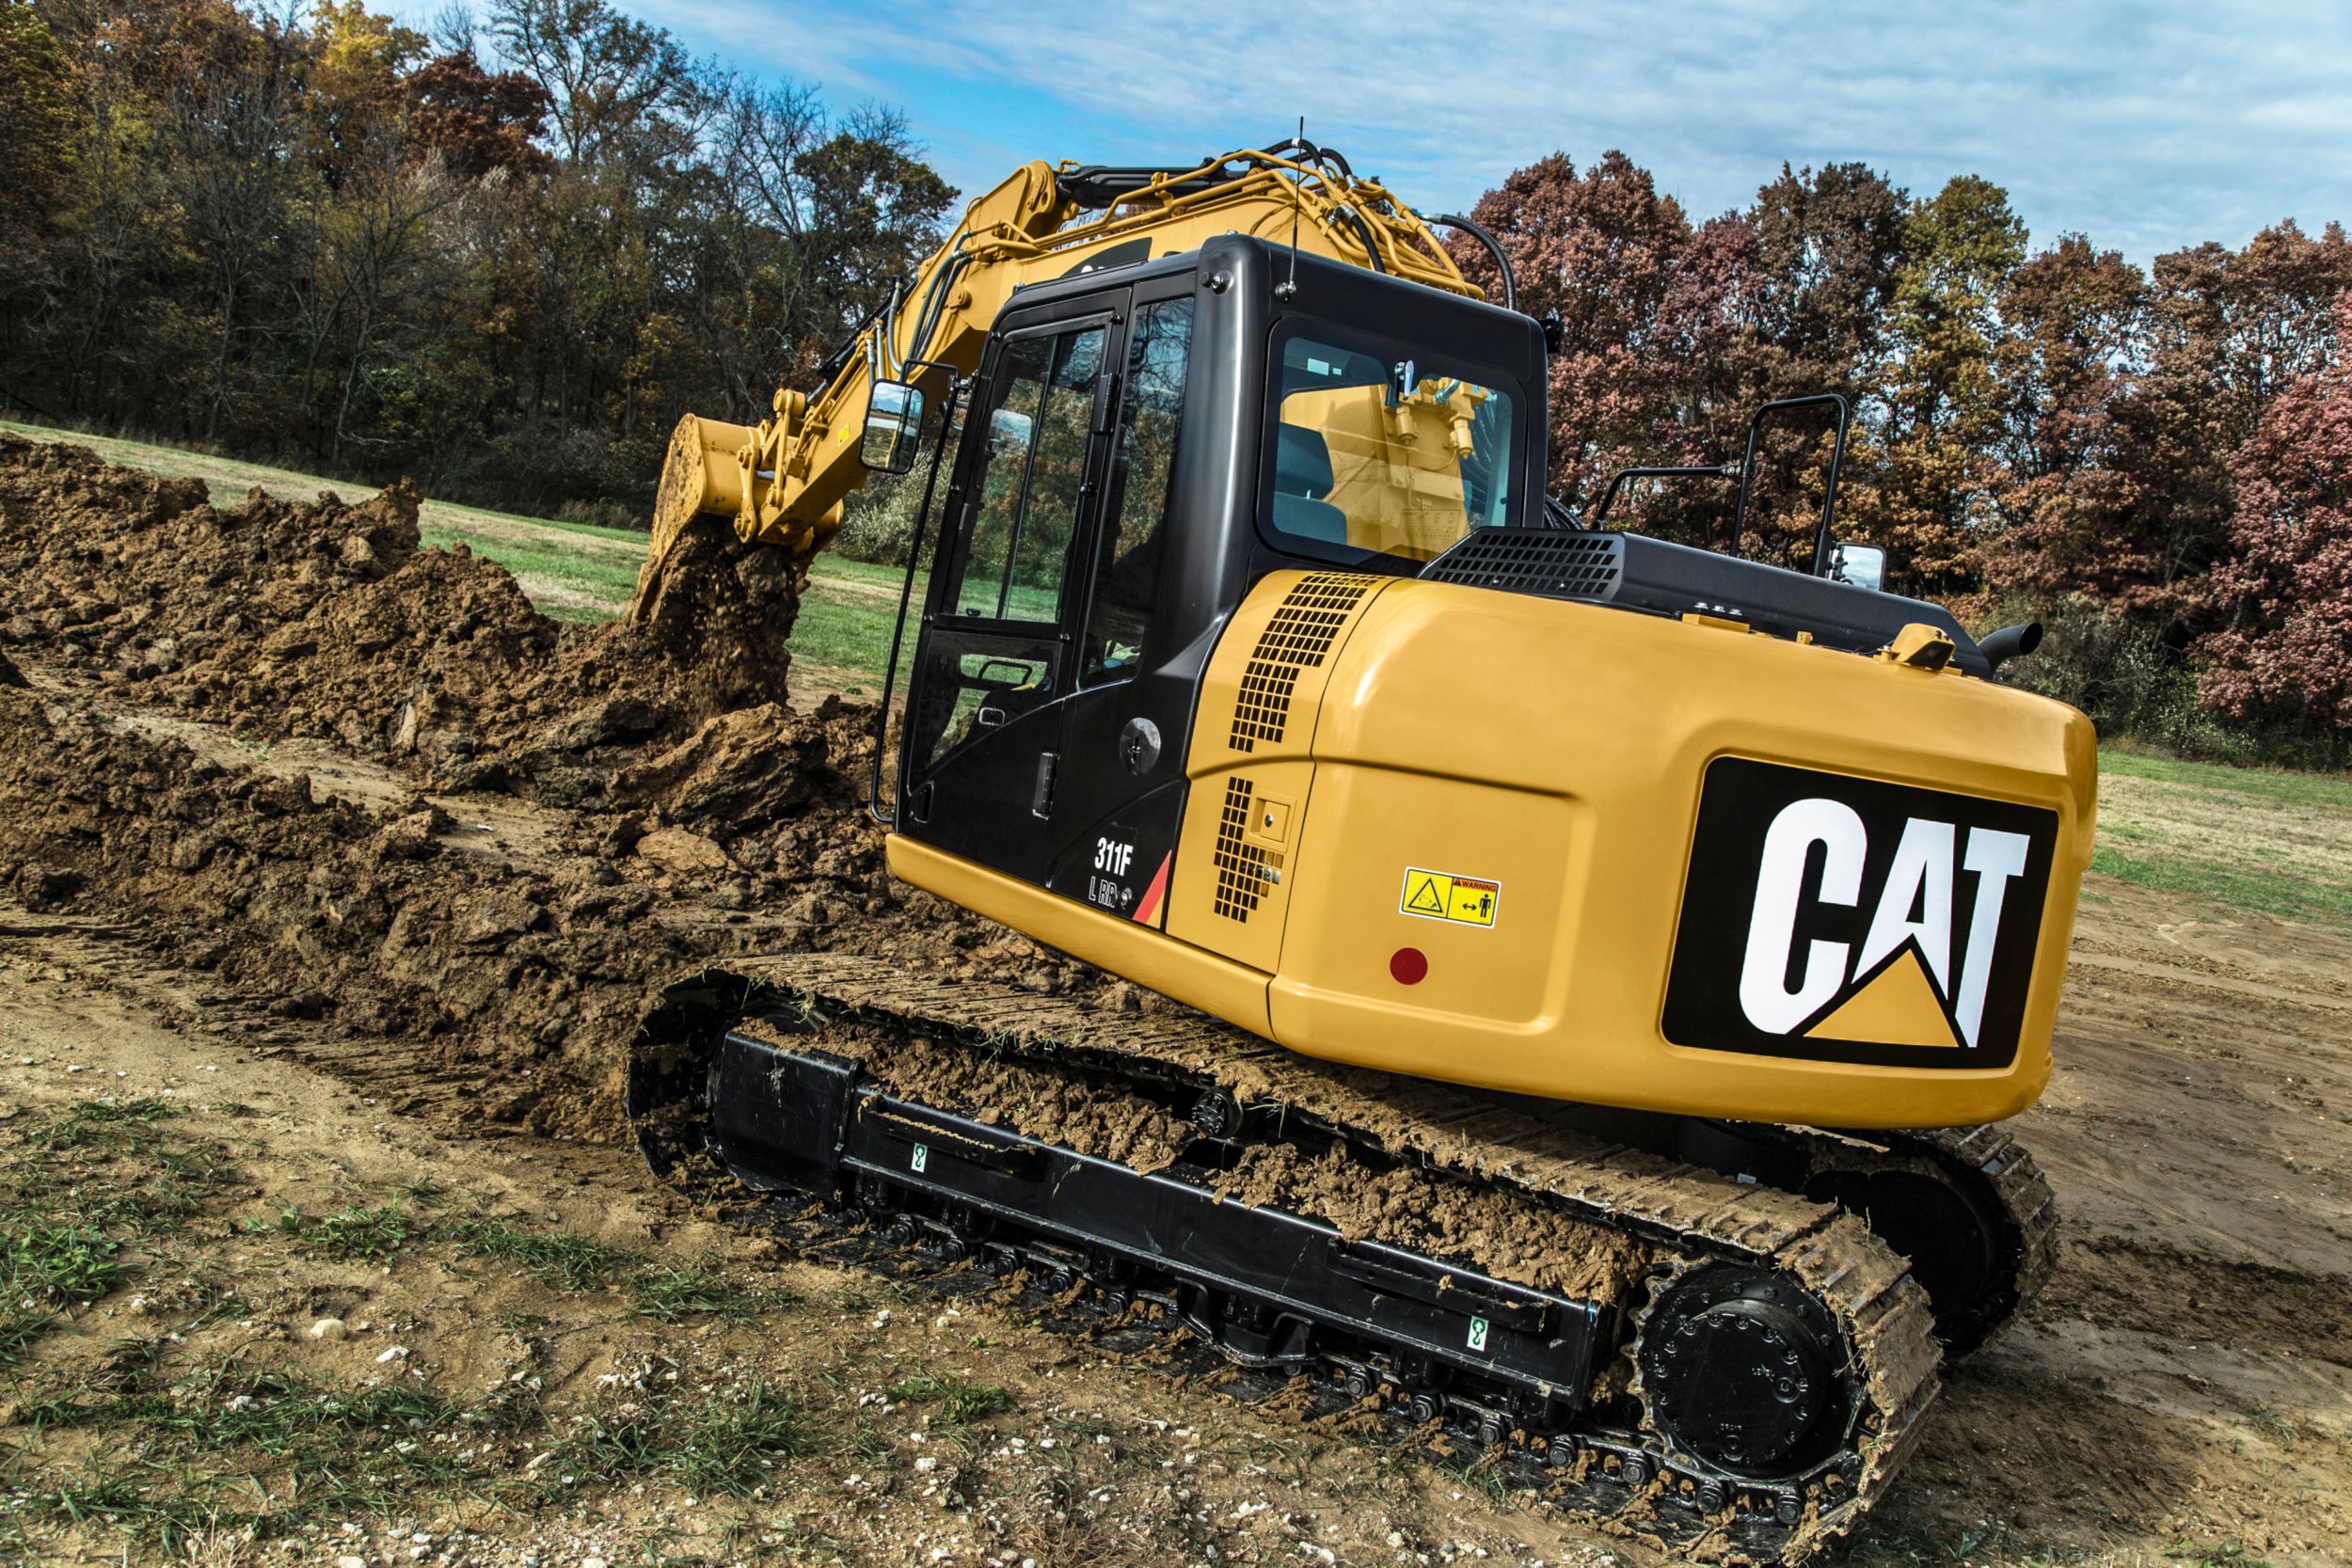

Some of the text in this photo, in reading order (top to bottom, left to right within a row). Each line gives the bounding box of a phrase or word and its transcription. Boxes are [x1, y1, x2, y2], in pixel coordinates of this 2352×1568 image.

[1095, 837, 1133, 876] 311F
[1089, 876, 1096, 901] L
[1462, 880, 1496, 892] WARNING
[1739, 797, 2031, 1048] CAT
